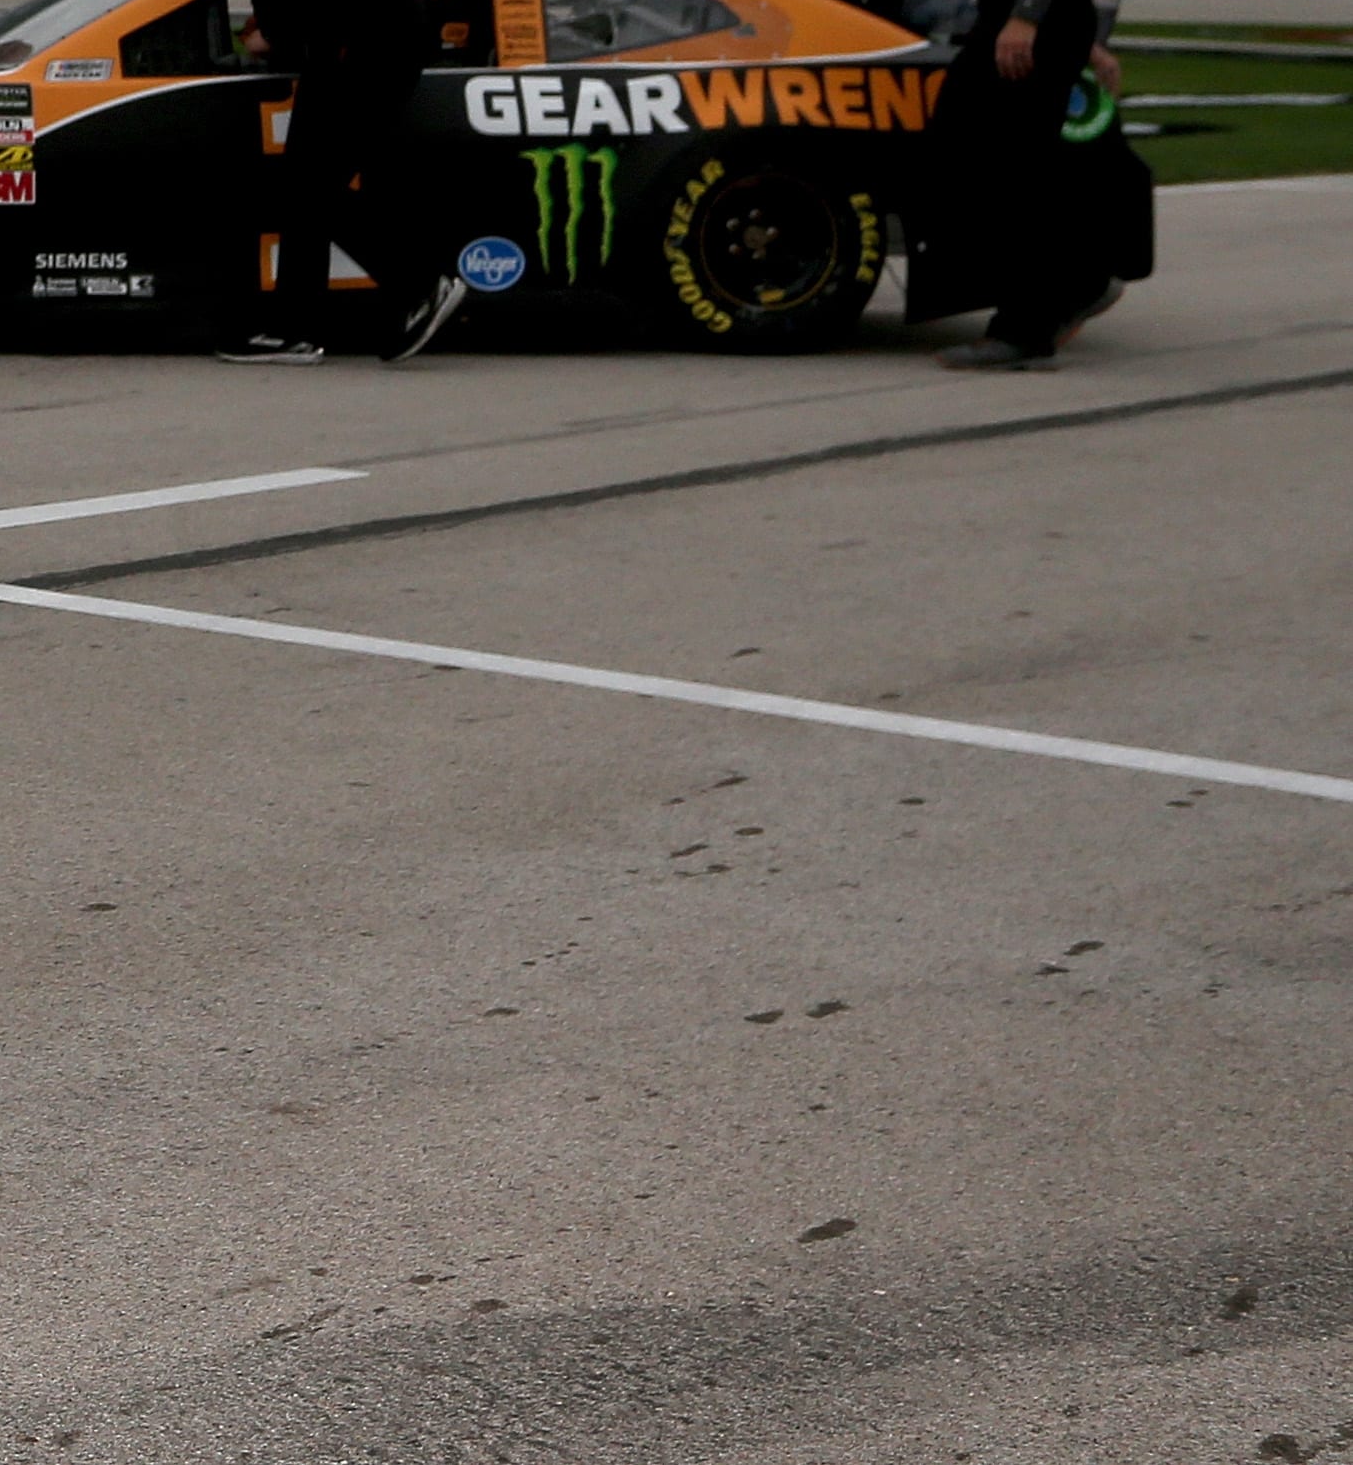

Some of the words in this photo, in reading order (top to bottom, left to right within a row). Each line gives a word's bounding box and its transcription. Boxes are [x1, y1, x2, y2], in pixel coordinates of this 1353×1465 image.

[35, 252, 129, 270] SIEMENS
[466, 245, 517, 284] Kroger
[664, 157, 733, 334] GOODYEAR
